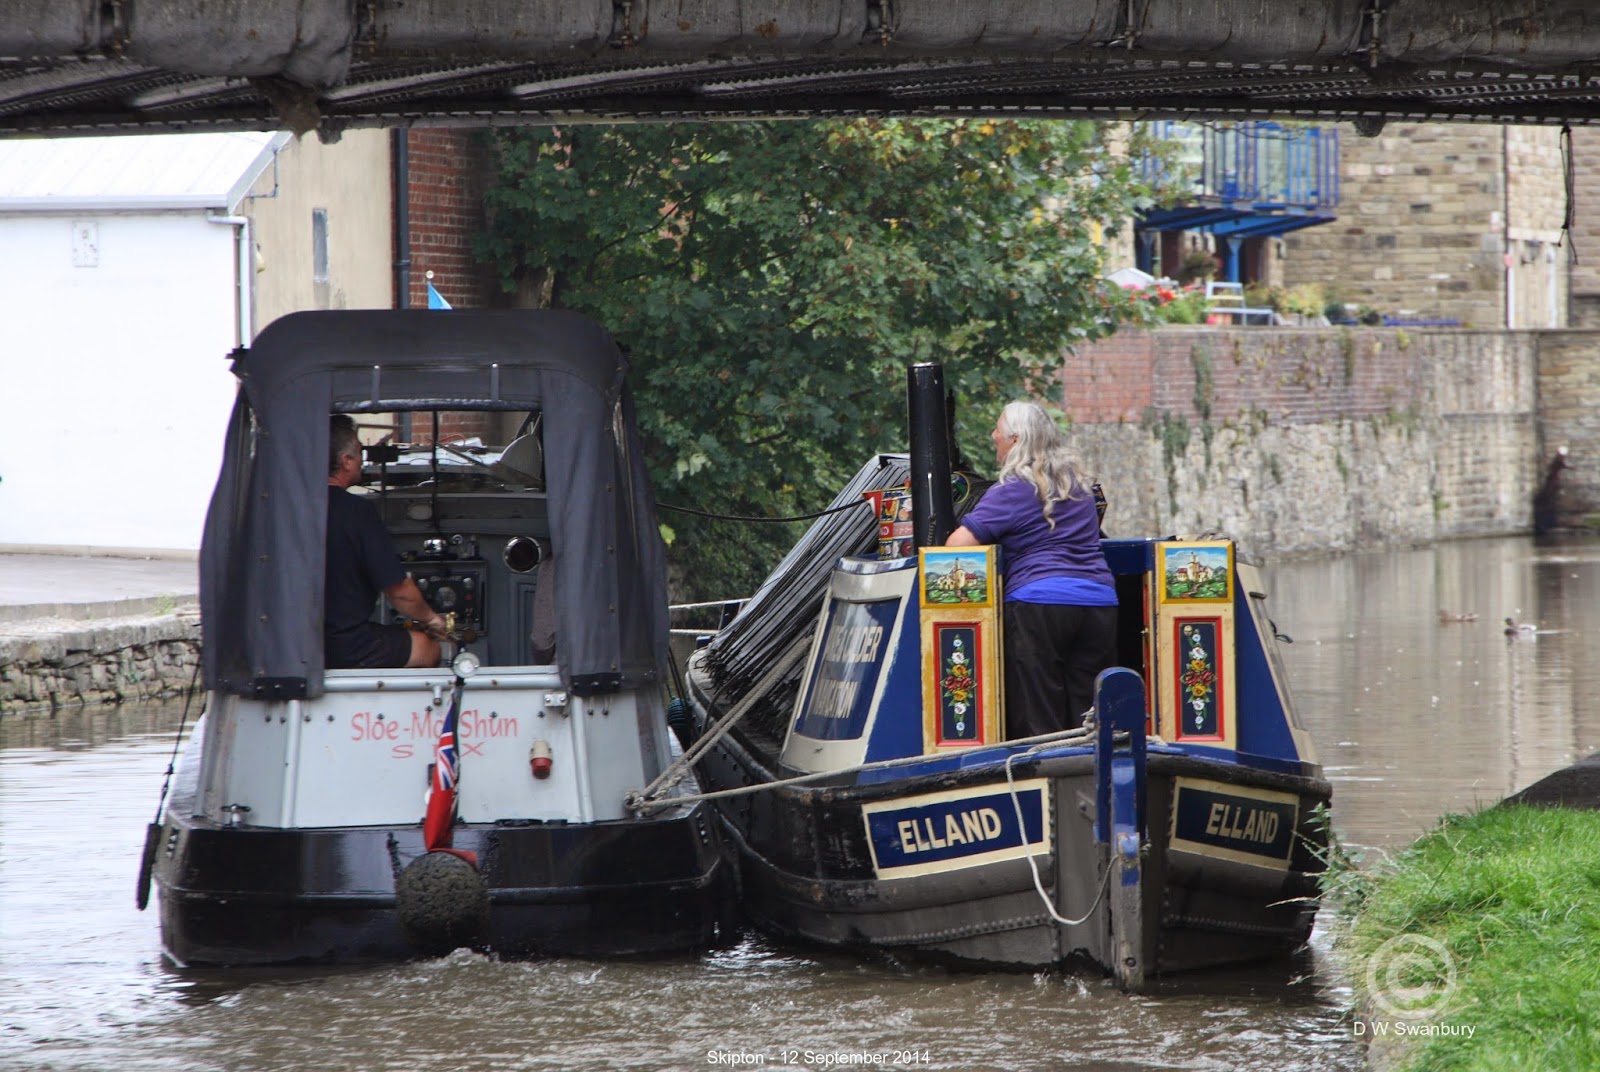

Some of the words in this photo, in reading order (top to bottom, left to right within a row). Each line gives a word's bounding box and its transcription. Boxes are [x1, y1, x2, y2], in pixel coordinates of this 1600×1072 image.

[459, 710, 519, 738] Shun
[897, 807, 1002, 854] ELLAND
[1205, 802, 1279, 844] ELLAND
